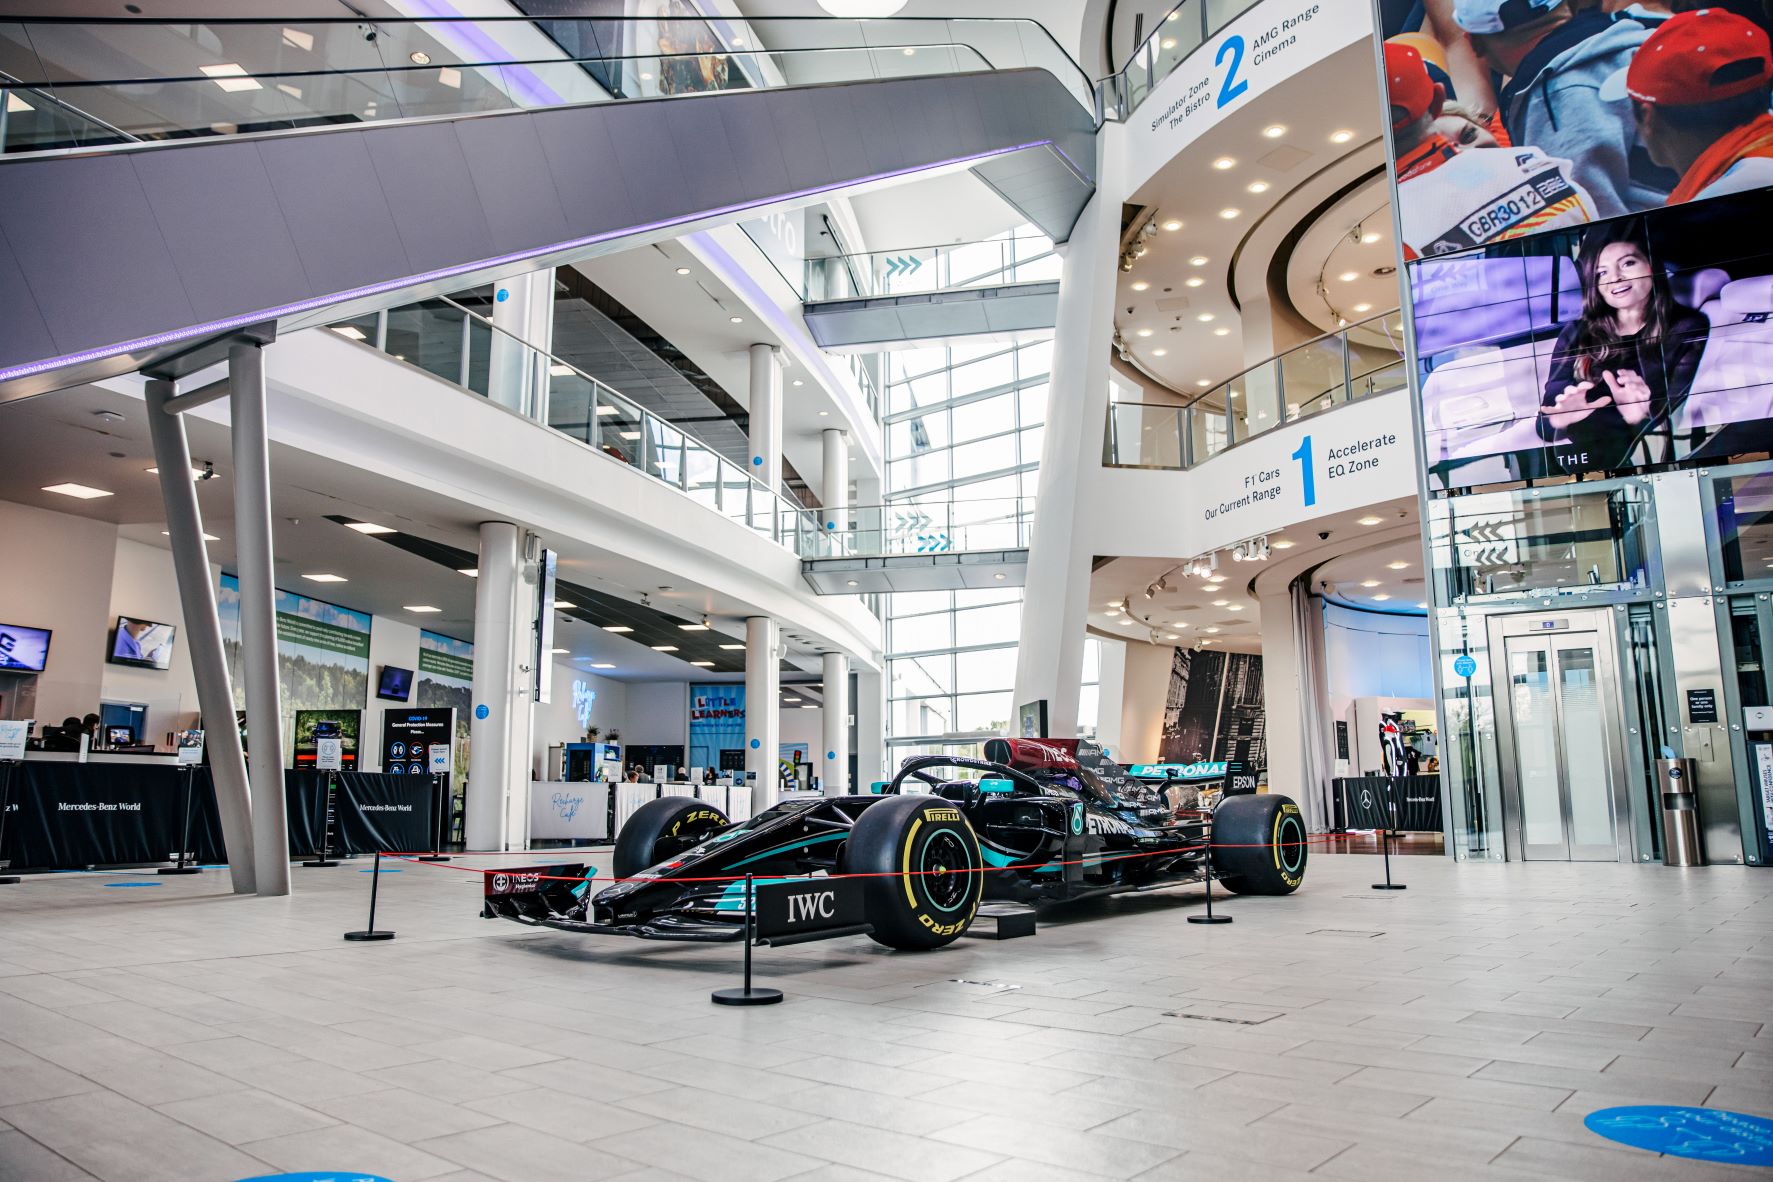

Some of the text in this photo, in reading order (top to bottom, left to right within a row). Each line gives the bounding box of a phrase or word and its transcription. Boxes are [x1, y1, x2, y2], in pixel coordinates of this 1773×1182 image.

[1252, 3, 1320, 52] AMG Range
[1253, 35, 1297, 67] Cinema
[1214, 34, 1249, 110] 2
[1151, 76, 1210, 132] Simulator Zone
[1169, 91, 1211, 131] The Bistro
[1328, 433, 1397, 461] Accelerate
[1328, 457, 1380, 480] EQ Zone
[1557, 452, 1589, 467] THE
[1244, 468, 1281, 489] F1 Cars
[1291, 435, 1316, 508] 1
[1204, 485, 1281, 521] Our Current Range
[691, 708, 746, 720] LEARNERS
[697, 697, 737, 708] LITTLE
[1232, 775, 1256, 789] EPSON
[58, 802, 141, 811] Mercedes-Benz World
[397, 804, 412, 812] World
[923, 808, 960, 822] PIRELLI
[686, 810, 728, 827] ZERO
[787, 890, 835, 923] IWC
[918, 913, 965, 936] ZERO
